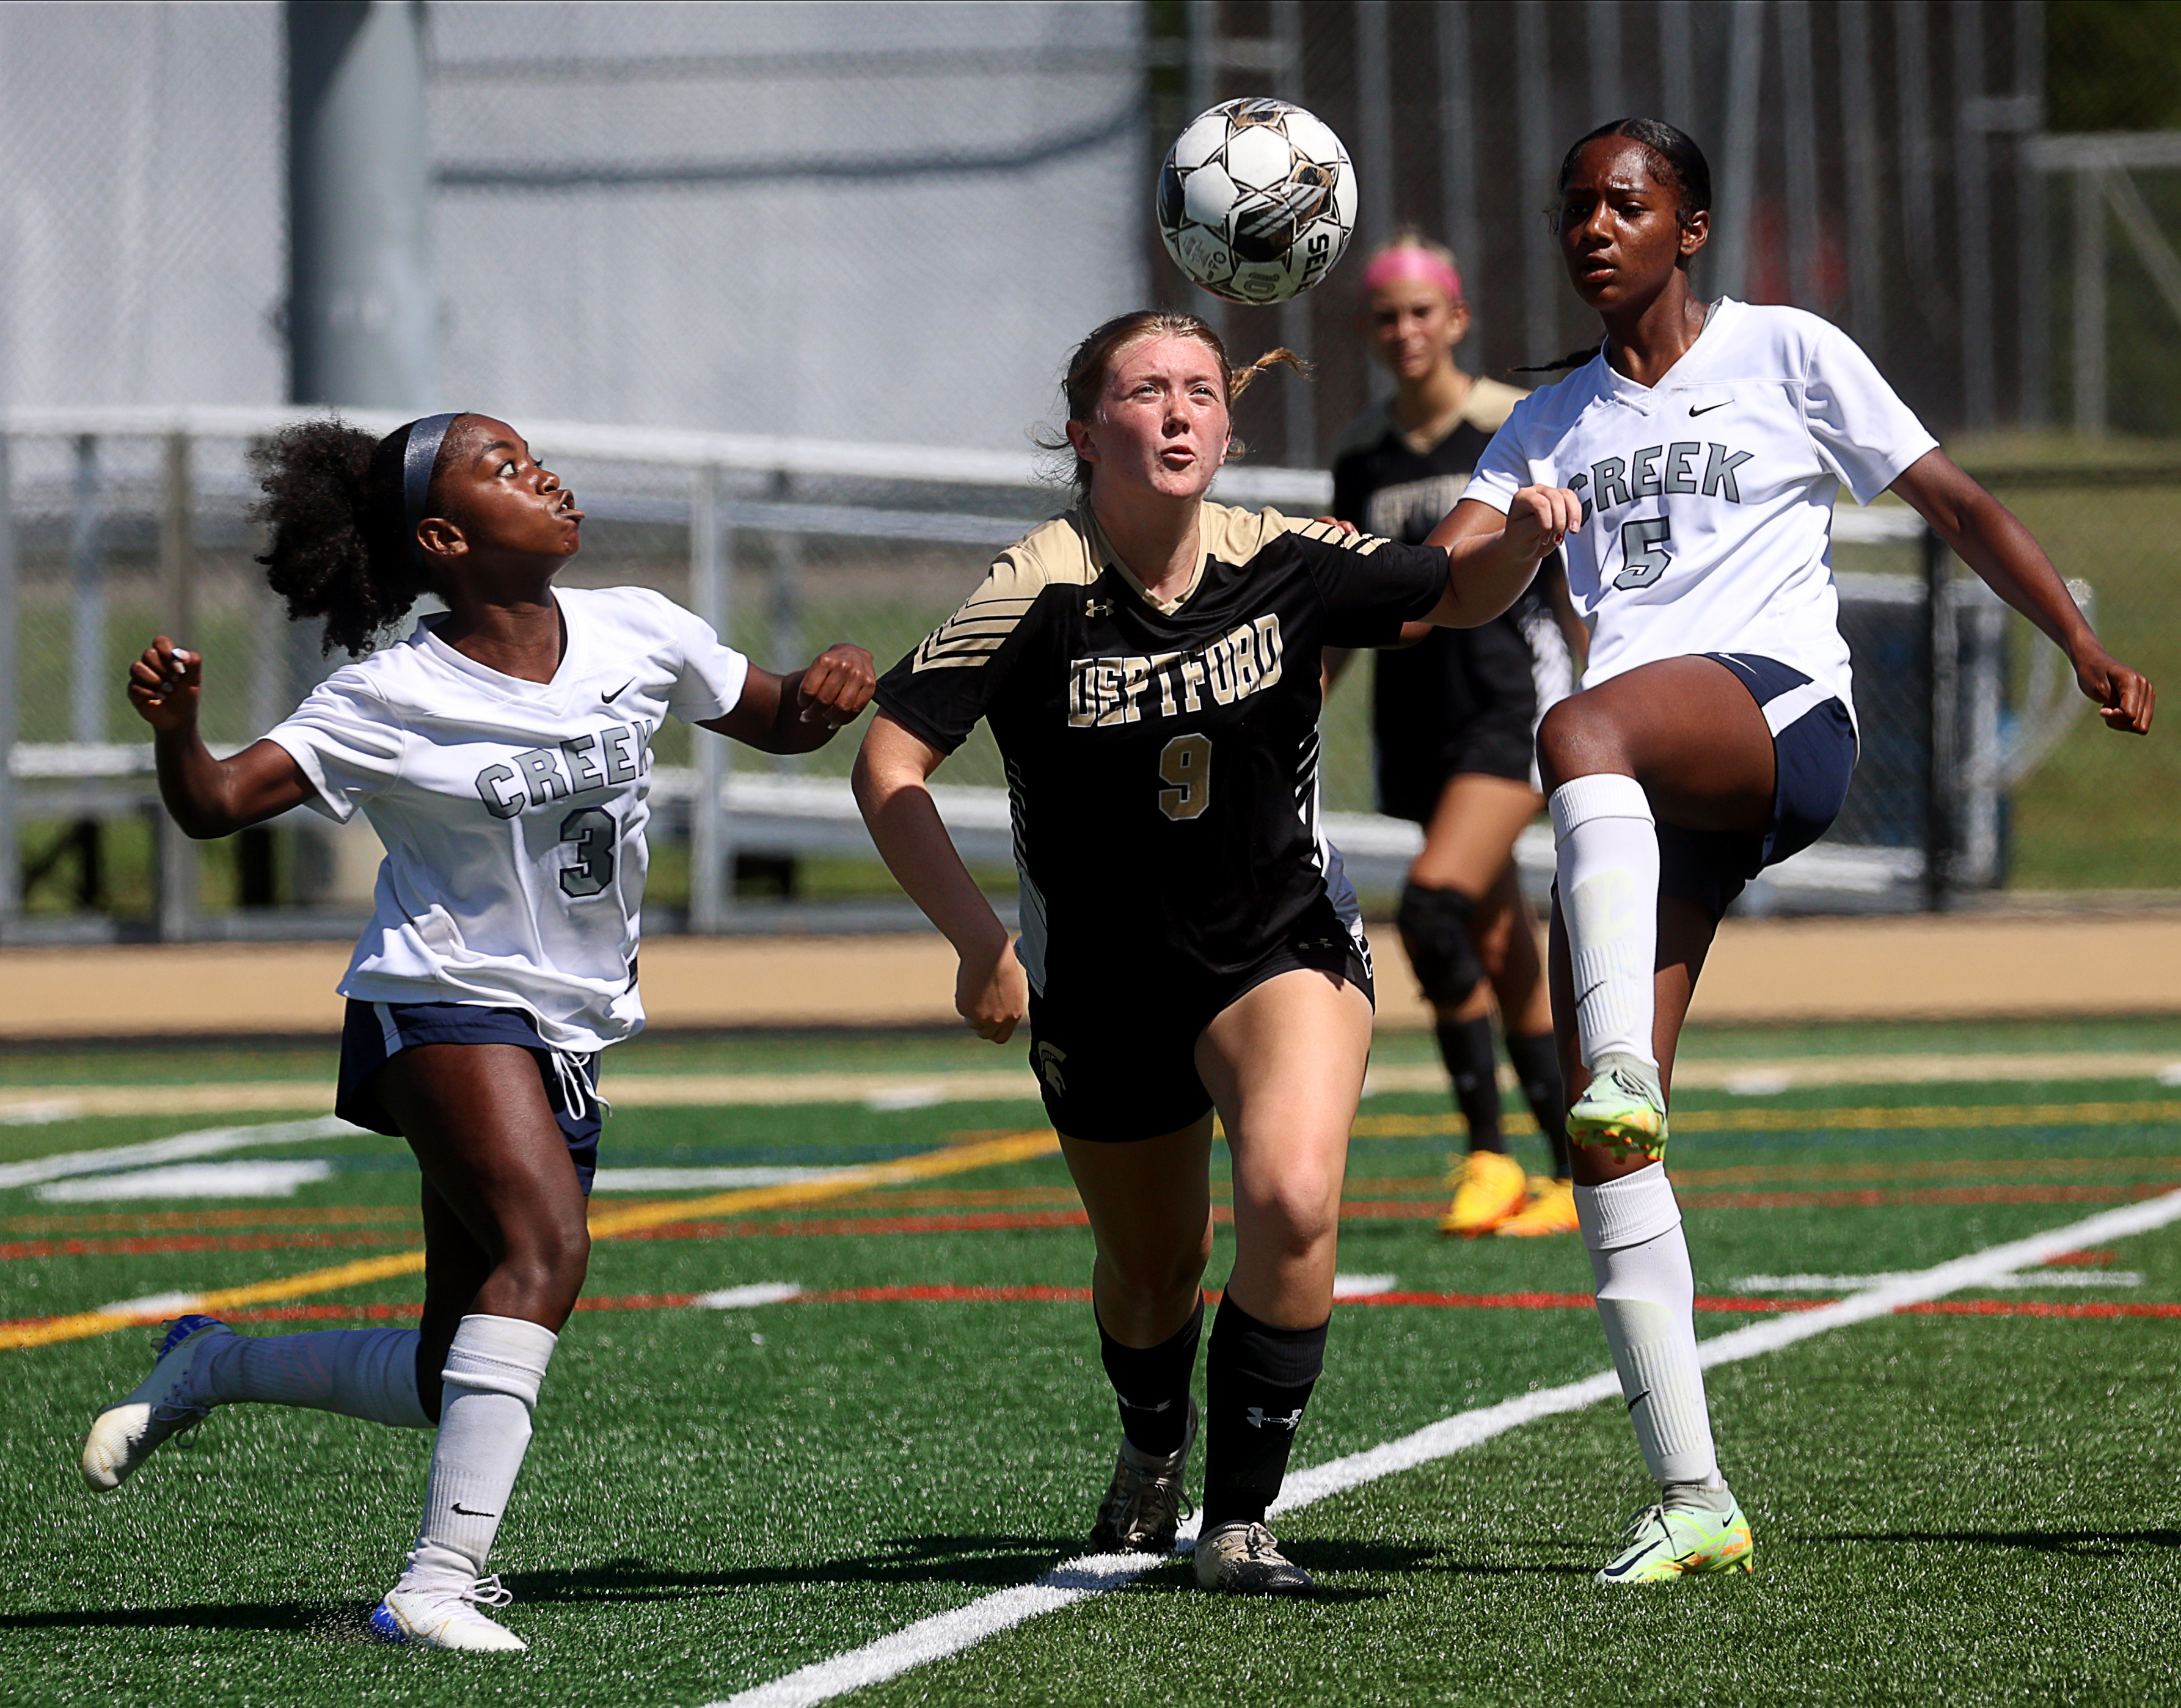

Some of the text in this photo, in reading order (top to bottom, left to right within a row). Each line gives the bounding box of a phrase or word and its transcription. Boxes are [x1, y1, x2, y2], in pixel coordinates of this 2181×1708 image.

[1612, 515, 1672, 591] 5
[1068, 613, 1284, 728] DEPTFORD
[475, 719, 654, 820] CREEK
[1158, 732, 1212, 821] 9
[559, 806, 616, 898] 3
